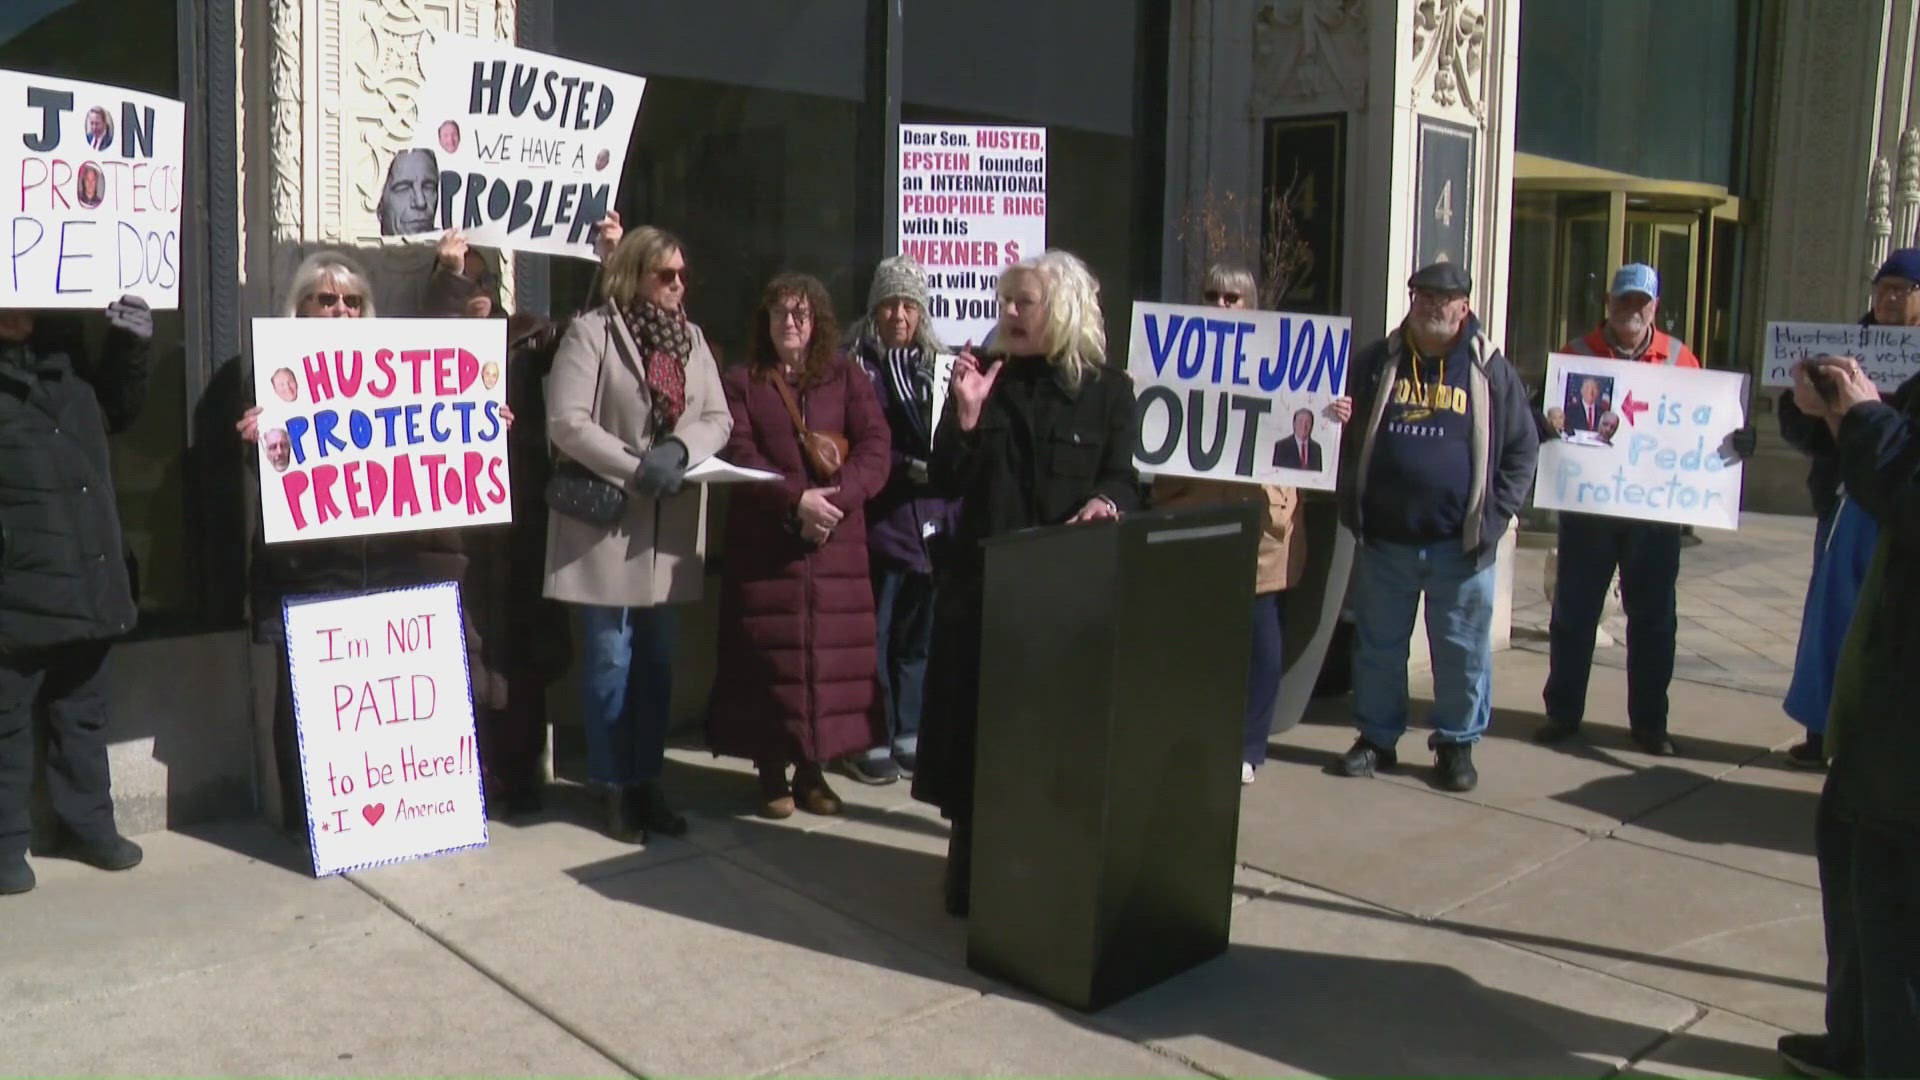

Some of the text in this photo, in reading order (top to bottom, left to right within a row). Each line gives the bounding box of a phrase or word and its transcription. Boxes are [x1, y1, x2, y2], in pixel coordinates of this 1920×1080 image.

[468, 60, 614, 130] HUSTED
[474, 129, 585, 169] WE HAVE A
[903, 130, 1044, 152] Dear Sen. HUSTED,
[903, 152, 1043, 172] EPSTEIN founded
[21, 157, 180, 212] PROTECTS
[903, 174, 1045, 193] an INTERNATIONAL
[440, 170, 610, 244] PROBLEM
[903, 195, 1044, 216] PEDOPHILE RING
[903, 218, 968, 235] with his
[903, 239, 1020, 266] WEXNER $
[928, 271, 999, 291] at will yo
[929, 294, 1002, 321] th you
[1144, 313, 1349, 396] VOTE JON
[303, 348, 480, 404] HUSTED
[1657, 394, 1712, 427] is a
[285, 400, 500, 464] PROTECTS
[1134, 385, 1272, 478] OUT
[1629, 431, 1724, 473] Pedo
[282, 451, 506, 531] PREDATORS
[1556, 458, 1721, 510] Protector
[387, 614, 436, 655] NOT
[334, 674, 436, 731] PAID
[328, 735, 473, 796] to be Here!!
[395, 798, 456, 822] America
